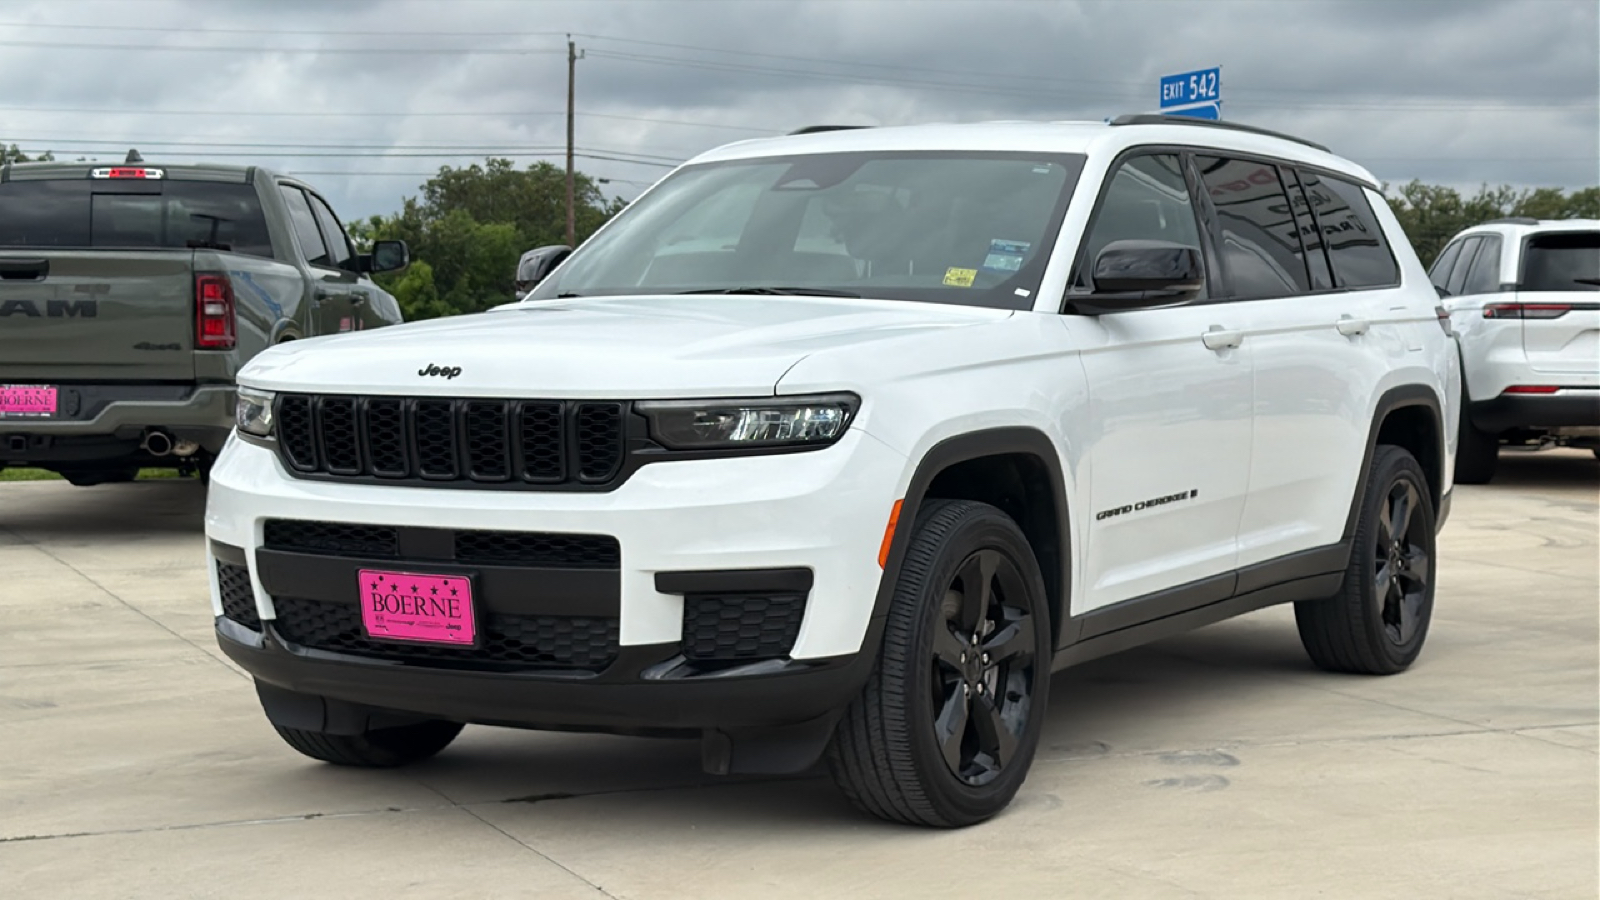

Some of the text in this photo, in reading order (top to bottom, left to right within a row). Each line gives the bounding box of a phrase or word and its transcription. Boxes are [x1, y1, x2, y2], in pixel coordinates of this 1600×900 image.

[1163, 72, 1216, 100] EXIT 542
[0, 300, 97, 317] AM
[418, 362, 463, 380] Jeep
[1096, 504, 1132, 521] GRAND
[1134, 491, 1188, 511] CHEROKEE
[371, 593, 462, 619] BOERNE
